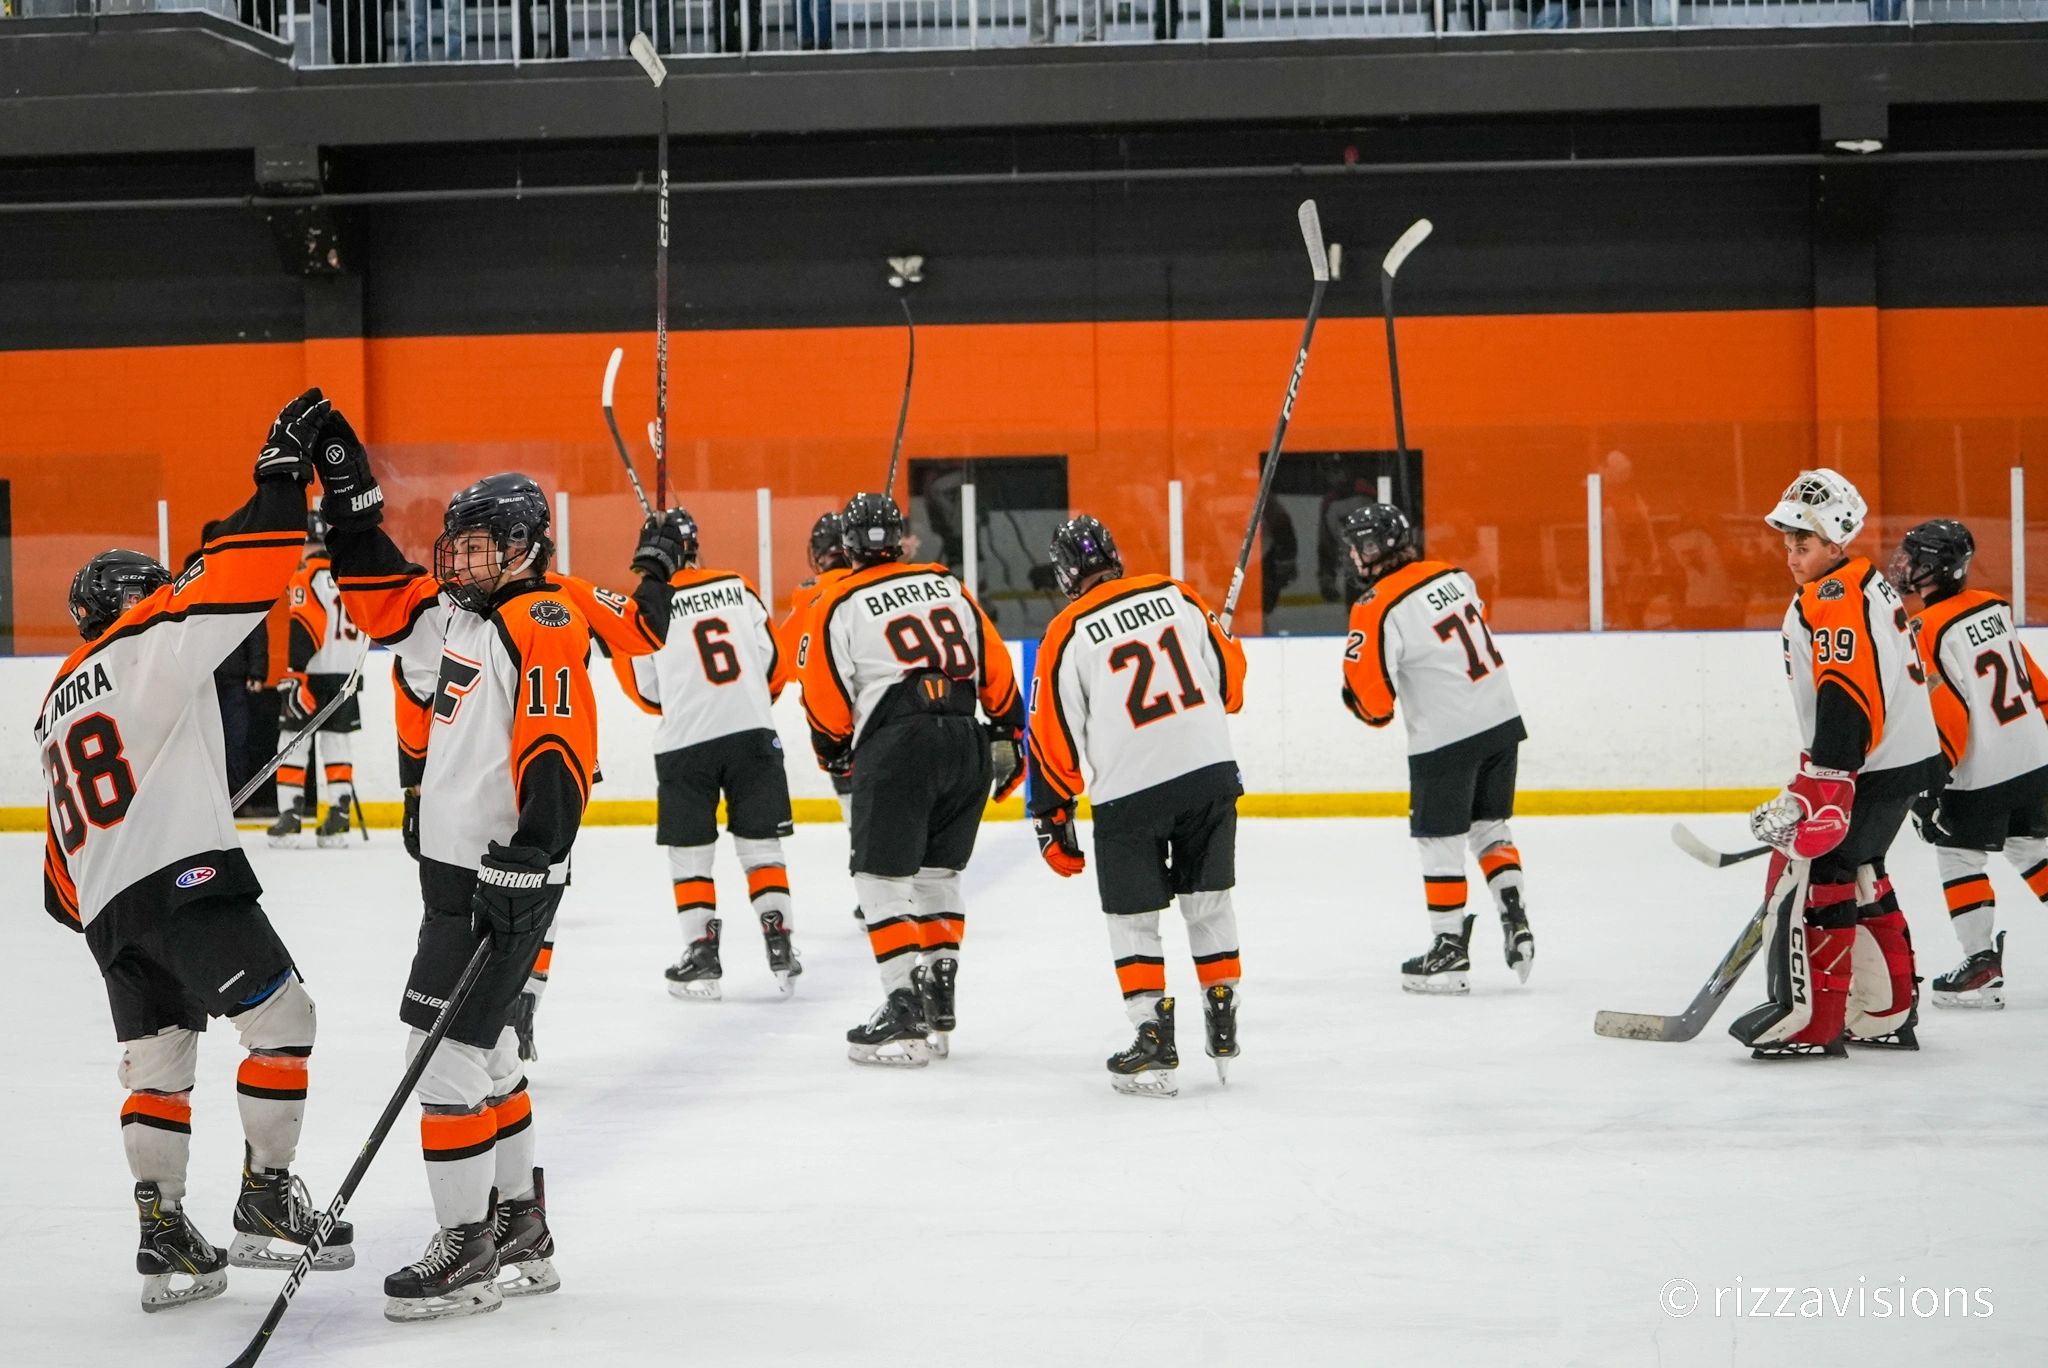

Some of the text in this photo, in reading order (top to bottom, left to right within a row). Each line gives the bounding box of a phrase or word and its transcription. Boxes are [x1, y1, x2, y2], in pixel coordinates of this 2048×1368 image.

[660, 169, 669, 248] CCM
[1282, 348, 1308, 421] CCM
[350, 485, 384, 512] RIOR
[669, 587, 744, 620] MMERMAN
[865, 579, 951, 616] BARRAS
[1085, 597, 1175, 645] DI IORIO
[1427, 582, 1464, 611] SAUL
[693, 616, 741, 686] 6
[884, 605, 977, 681] 98
[1431, 602, 1504, 683] 72
[1814, 627, 1857, 665] 39
[1965, 612, 2007, 647] ELSON
[527, 665, 572, 718] 11
[1108, 625, 1205, 729] 21
[47, 711, 138, 856] 88
[1792, 926, 1807, 1005] CCM
[281, 1195, 347, 1302] BAUER
[447, 1262, 471, 1284] CCM
